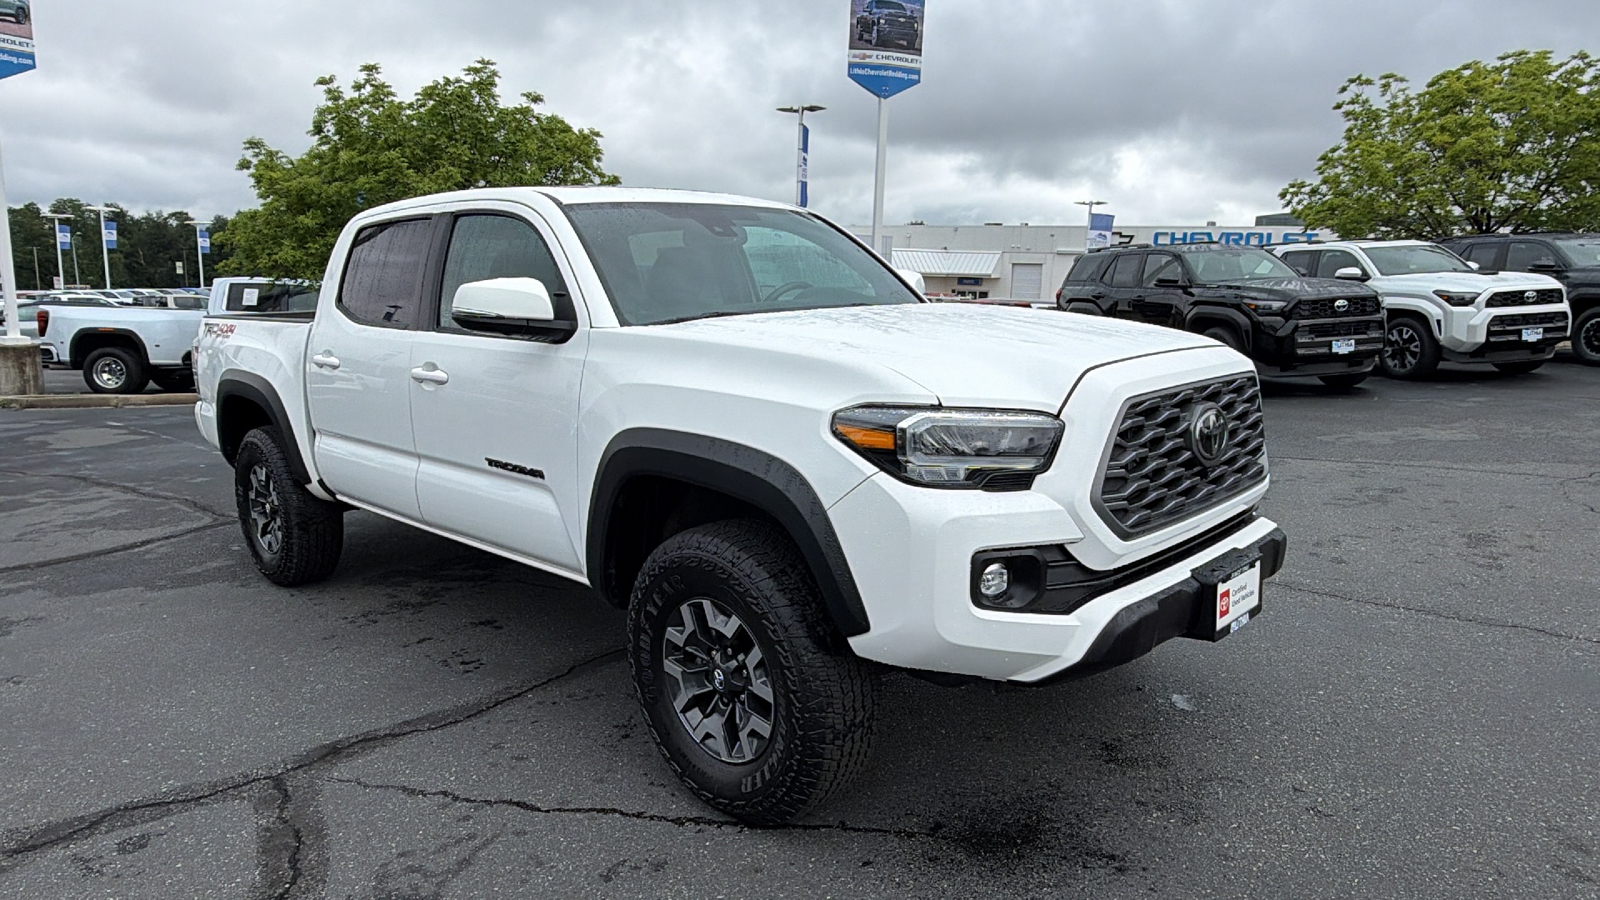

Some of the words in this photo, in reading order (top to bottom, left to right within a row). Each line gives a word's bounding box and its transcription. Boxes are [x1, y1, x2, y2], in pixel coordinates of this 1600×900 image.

[875, 54, 919, 65] CHEVROLET
[1153, 231, 1319, 247] CHEVROLET
[484, 456, 546, 481] TACOMA
[1231, 582, 1248, 597] Certified
